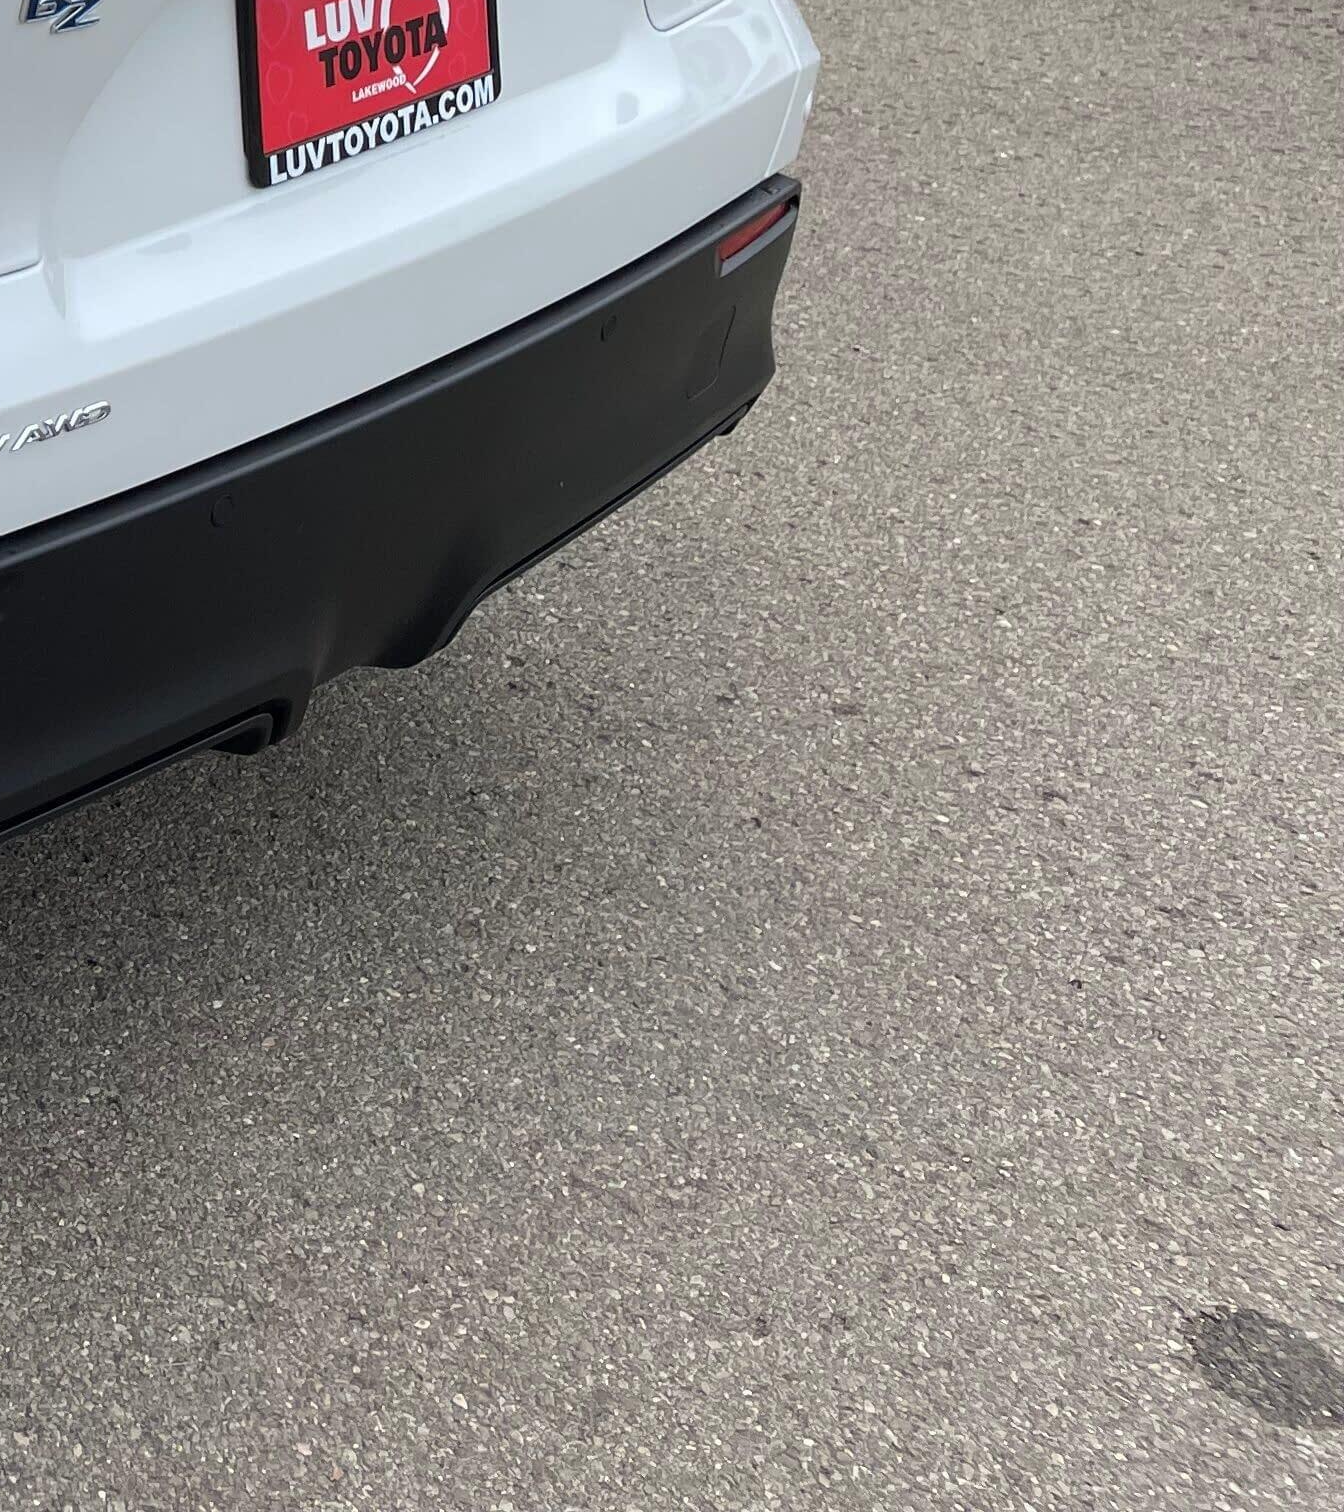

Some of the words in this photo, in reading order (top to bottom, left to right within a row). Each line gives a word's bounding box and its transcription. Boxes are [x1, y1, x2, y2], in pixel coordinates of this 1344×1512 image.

[318, 11, 448, 88] TOYOTA
[351, 74, 407, 103] LAKEWOOD
[269, 75, 494, 185] LUVTOYOTA.COM
[10, 399, 112, 452] AWD
